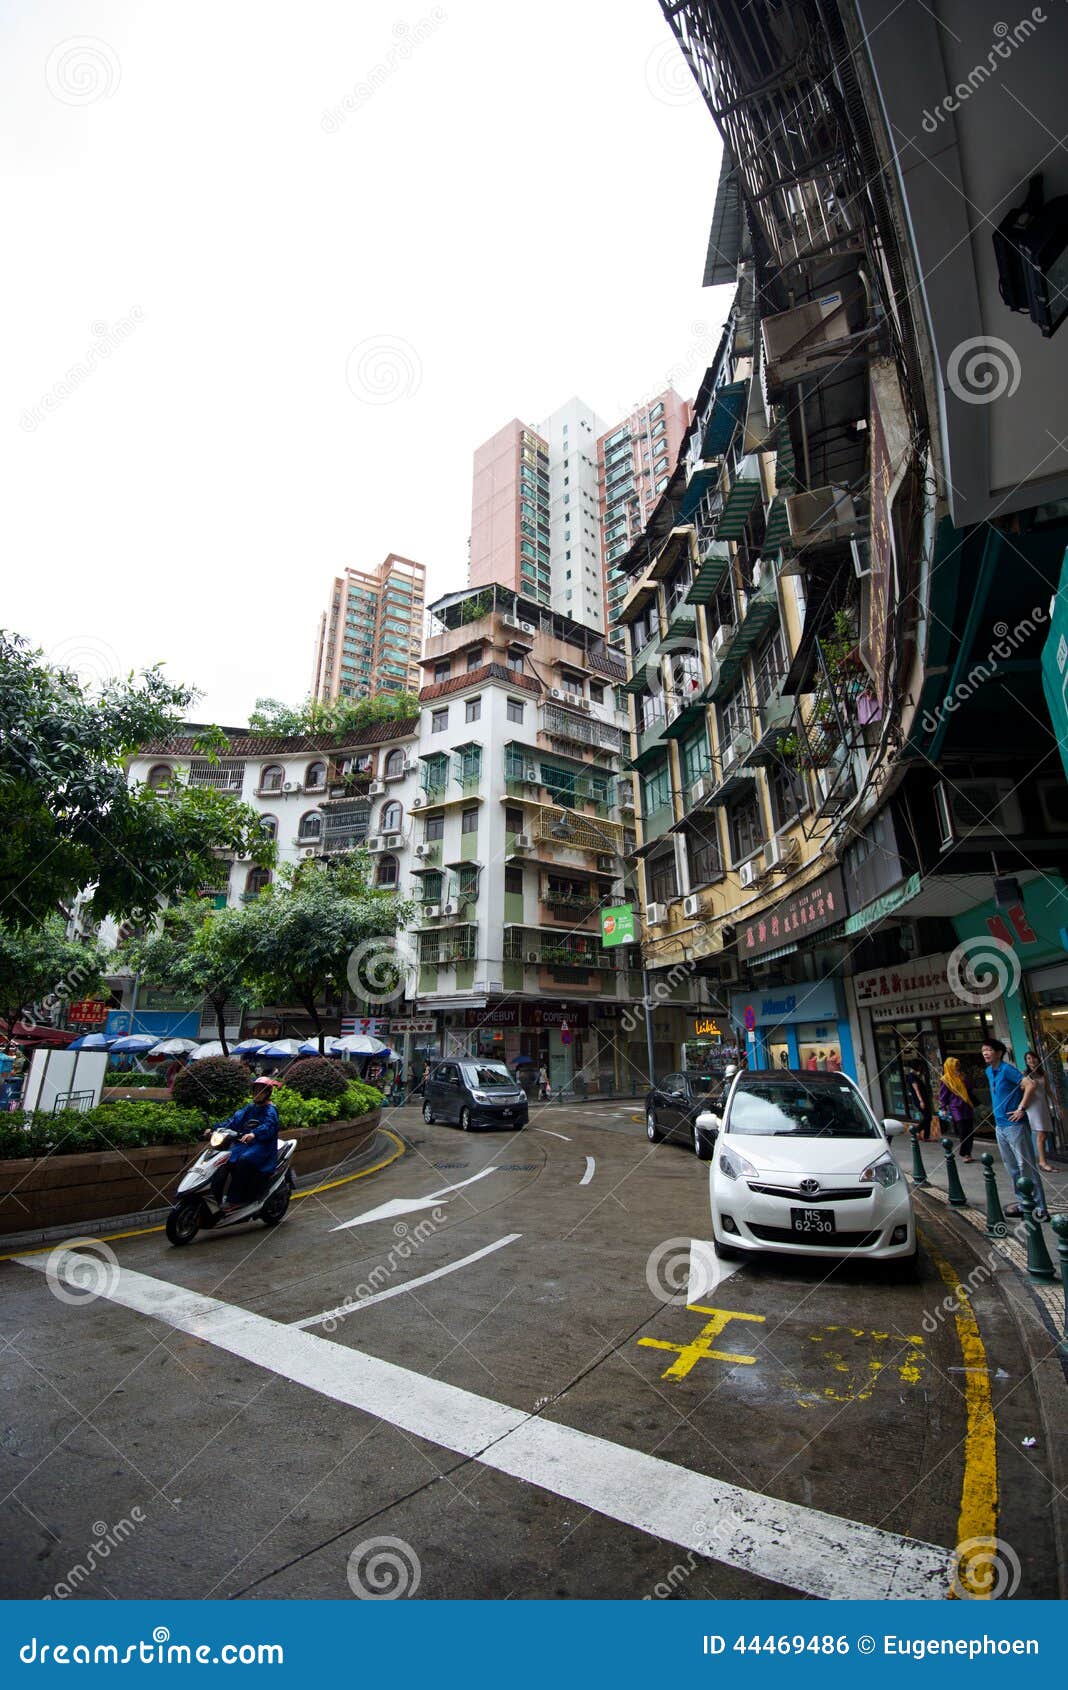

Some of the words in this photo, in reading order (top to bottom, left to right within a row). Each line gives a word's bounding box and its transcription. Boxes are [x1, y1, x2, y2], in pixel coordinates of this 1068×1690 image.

[476, 1009, 516, 1021] COMEBUY
[804, 1210, 820, 1221] MS
[795, 1220, 832, 1232] 62-30
